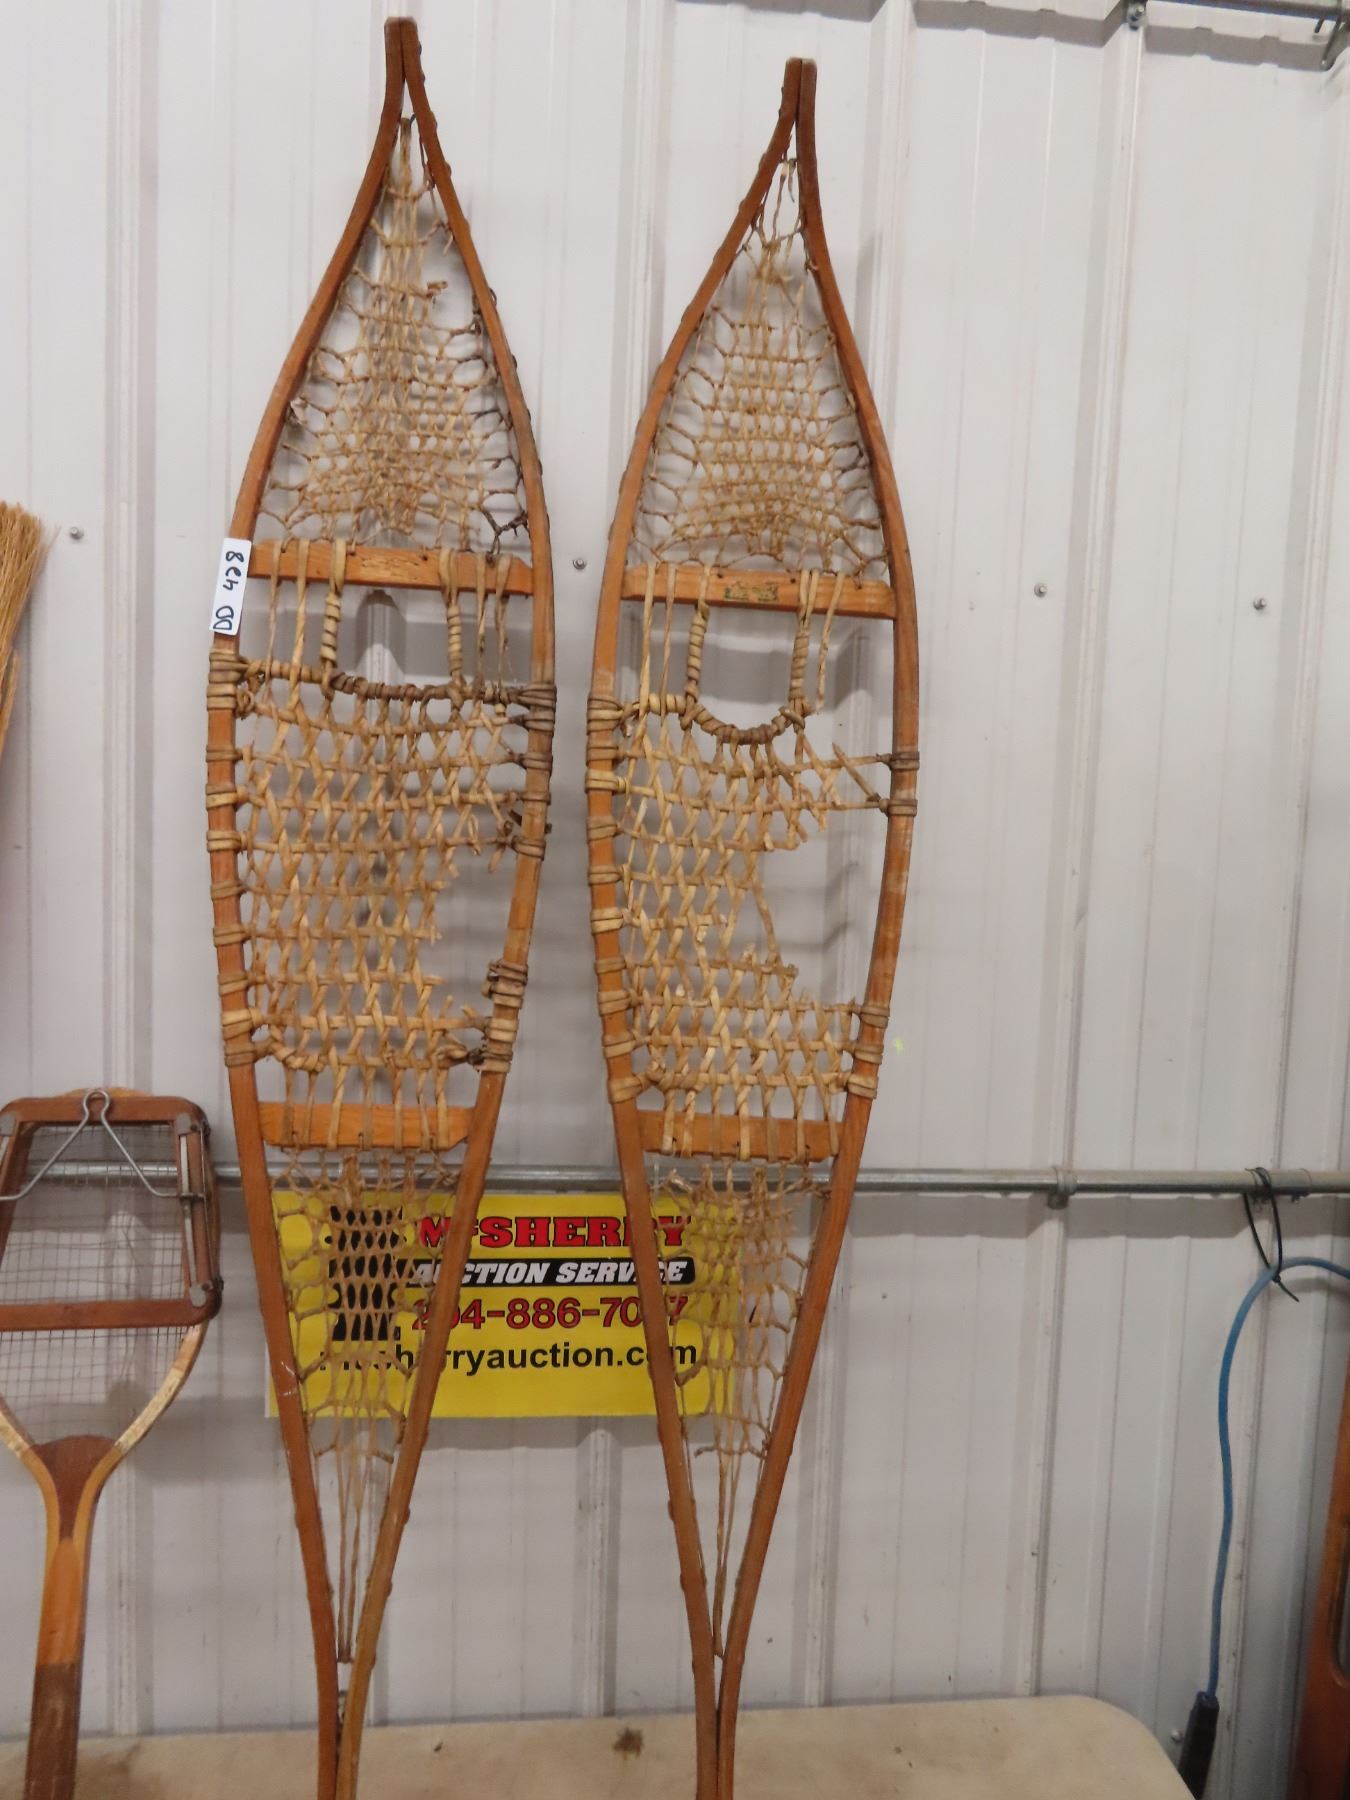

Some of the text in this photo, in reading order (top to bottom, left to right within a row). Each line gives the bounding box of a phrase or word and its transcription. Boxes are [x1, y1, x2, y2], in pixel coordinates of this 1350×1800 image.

[212, 550, 245, 631] DD 428
[419, 1215, 692, 1248] MSHERY
[556, 1260, 688, 1284] SERVE
[411, 1295, 689, 1330] 24-886-707
